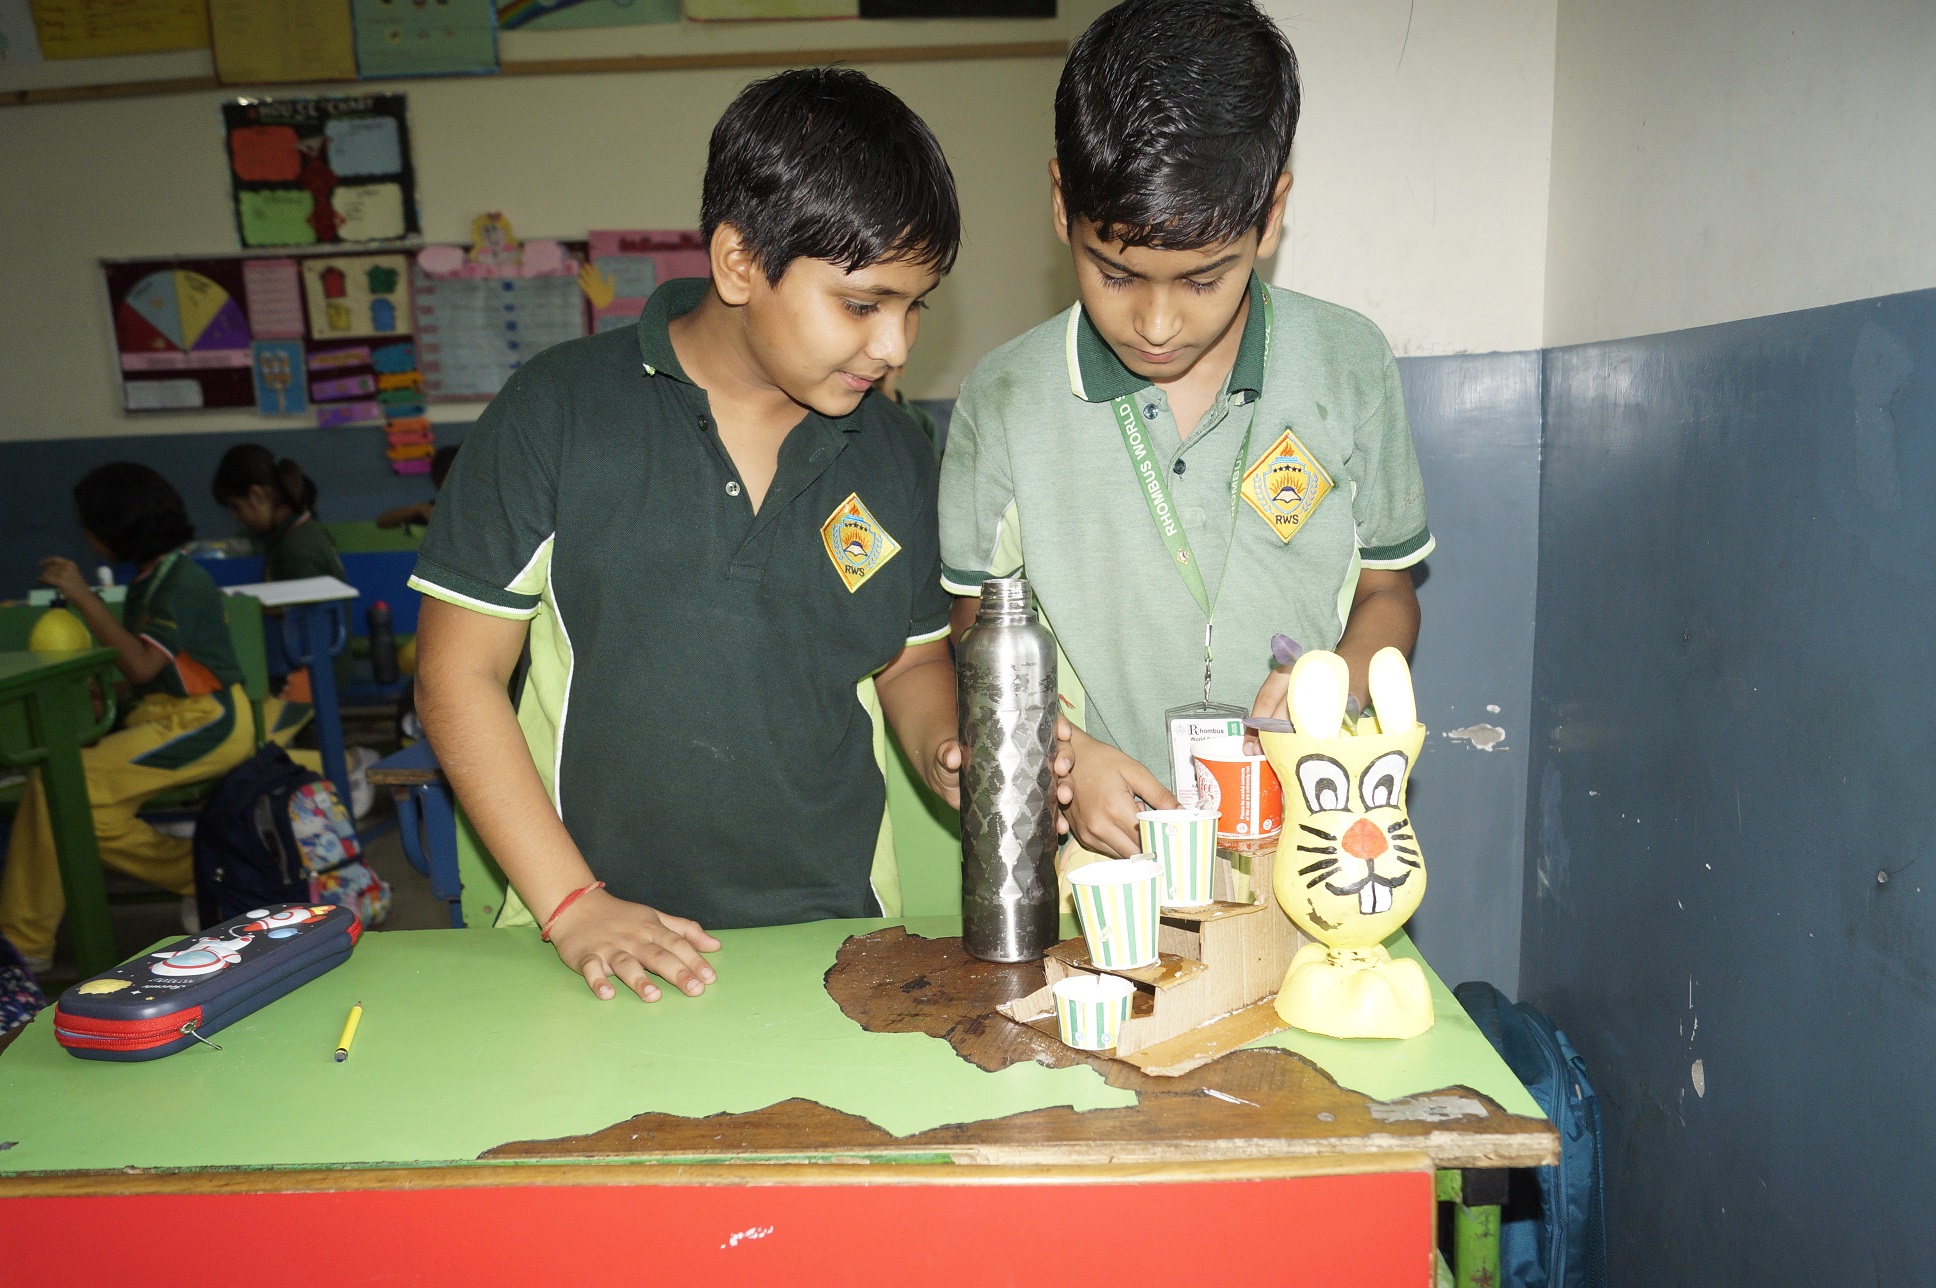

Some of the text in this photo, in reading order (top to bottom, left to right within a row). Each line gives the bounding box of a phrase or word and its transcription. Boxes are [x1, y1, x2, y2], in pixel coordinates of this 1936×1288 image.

[1119, 403, 1178, 537] RHOMBUS WORLD
[1231, 449, 1244, 519] HOMBUS
[1275, 514, 1299, 525] RWS
[844, 564, 866, 577] RWS
[1188, 724, 1225, 736] Rhombus
